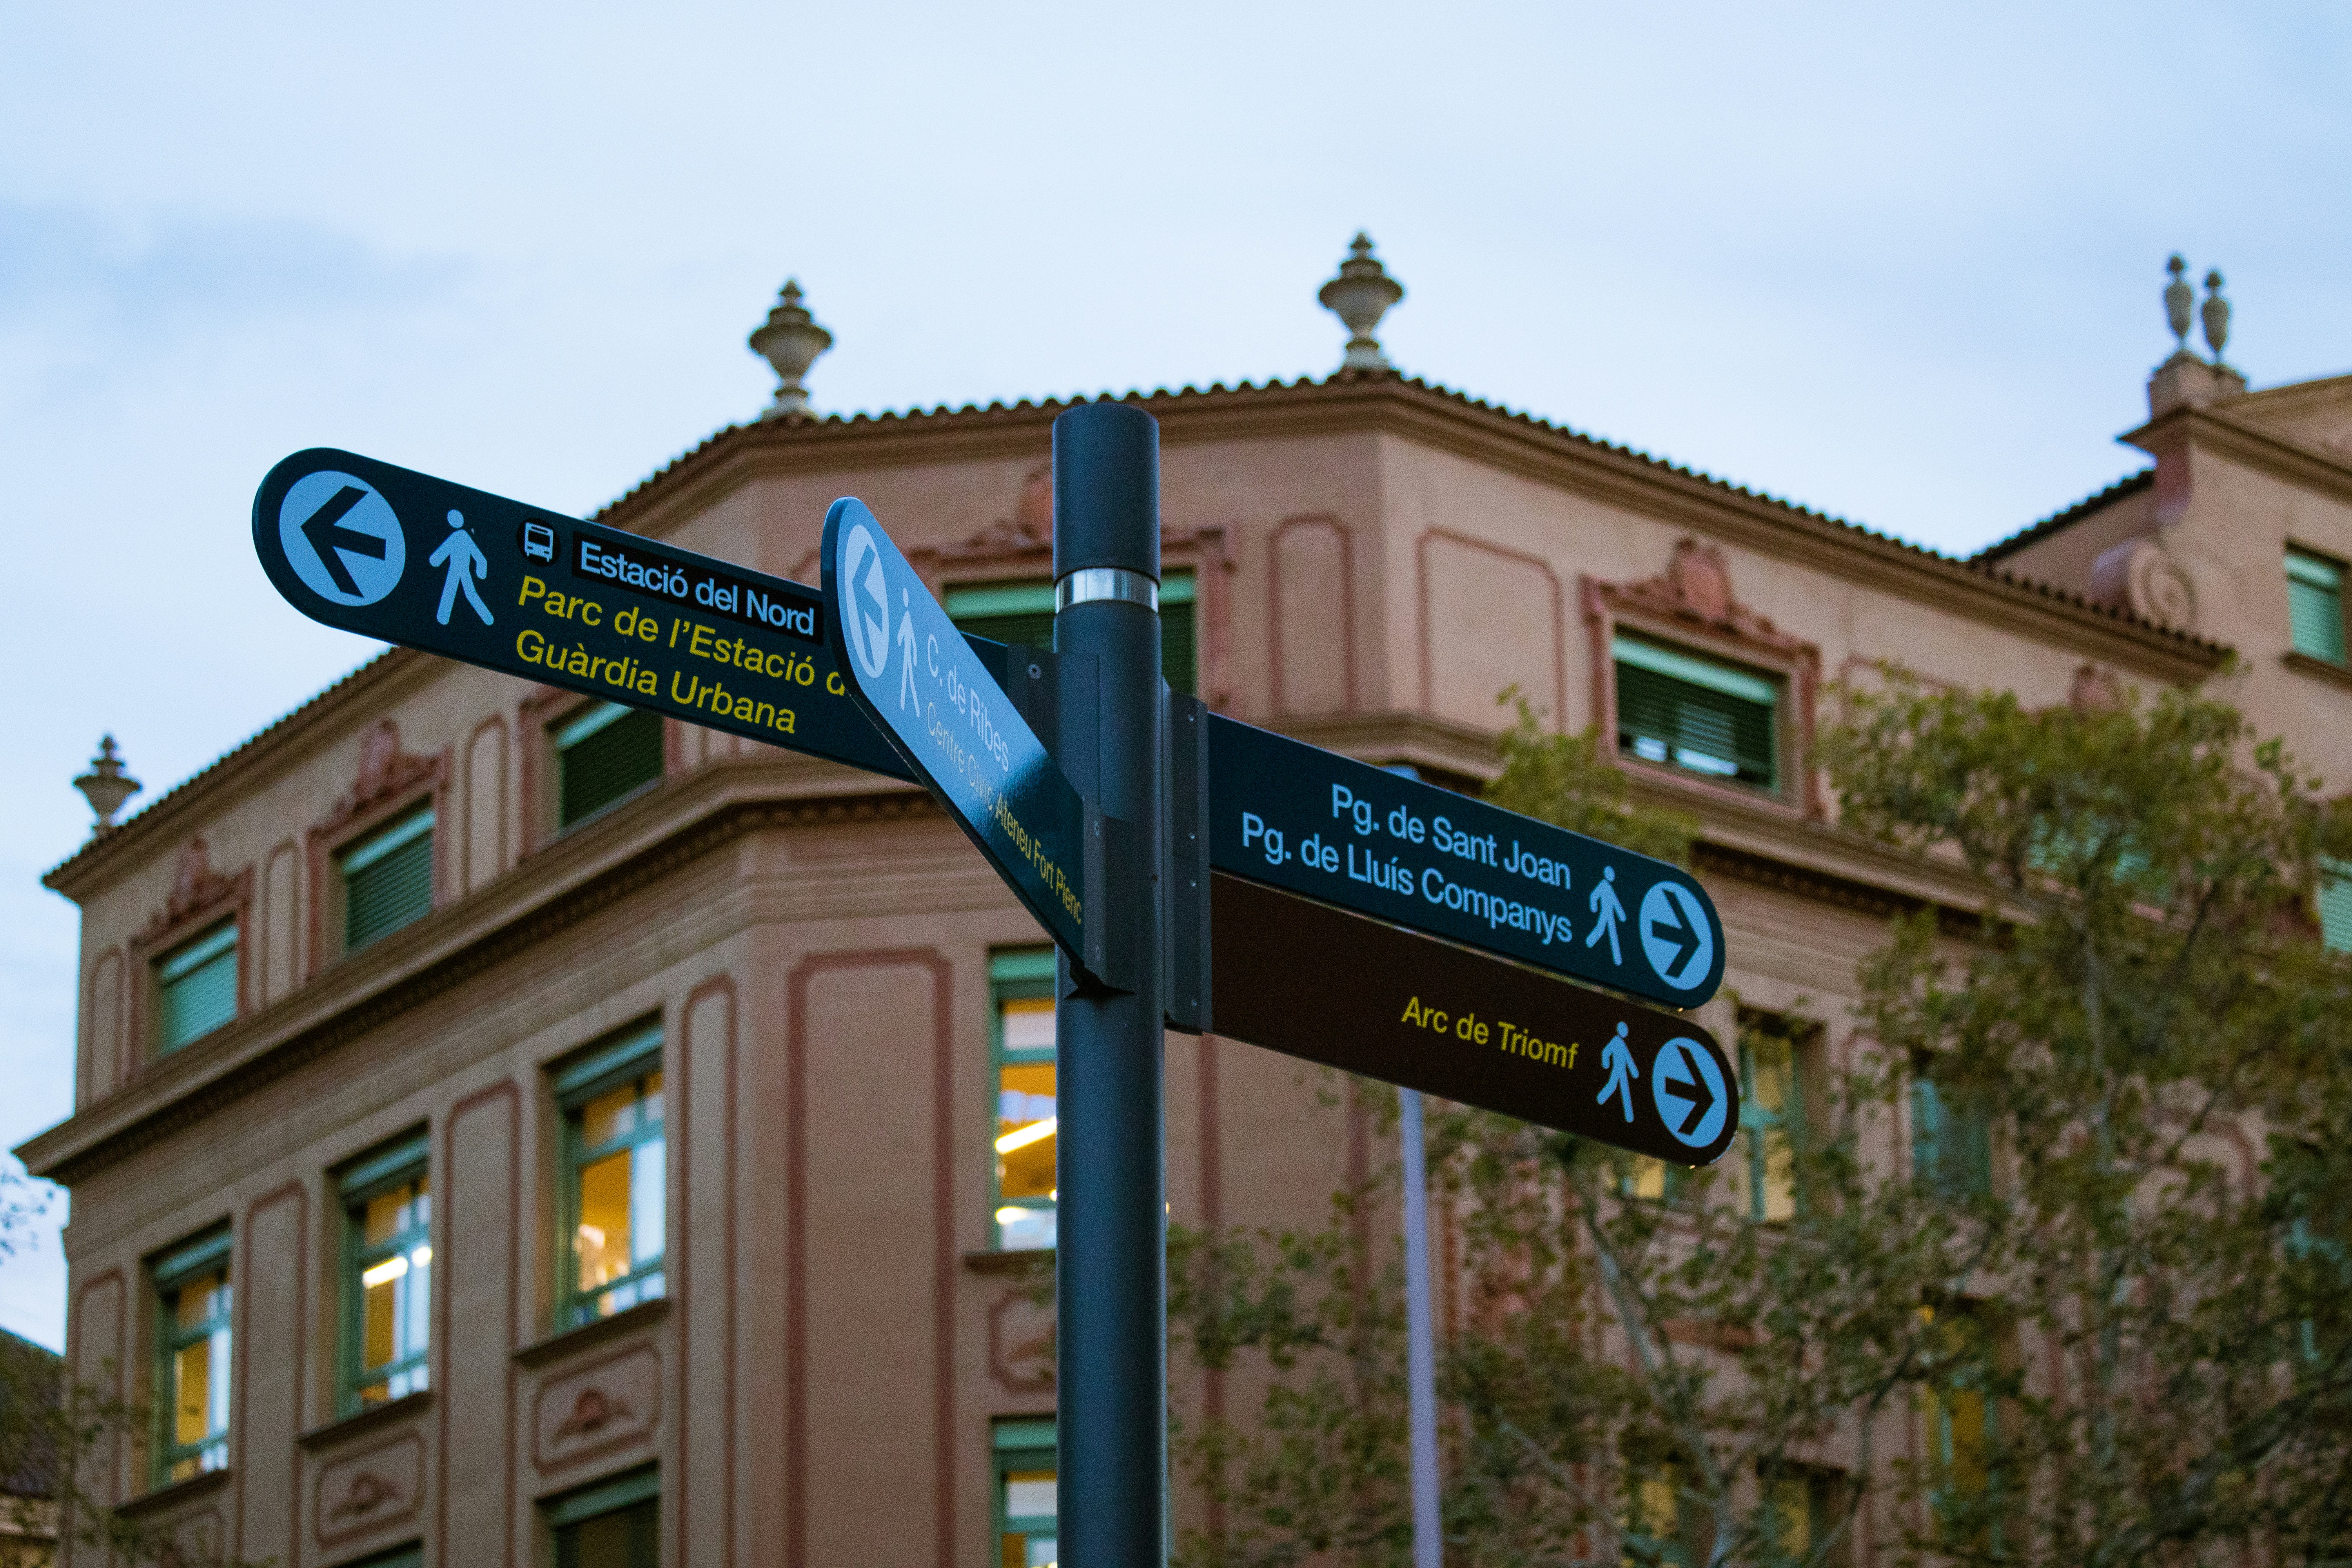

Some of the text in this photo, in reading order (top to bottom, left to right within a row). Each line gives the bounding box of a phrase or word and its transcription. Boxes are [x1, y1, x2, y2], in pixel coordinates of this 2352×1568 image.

[518, 575, 602, 626] Parc
[614, 607, 659, 642] de
[581, 541, 815, 636] Estació del Nord
[516, 630, 795, 733] Guàrdia Urbana
[927, 633, 1009, 772] C. de Ribes
[927, 702, 964, 773] Centre
[995, 792, 1031, 860] Ateneu
[1034, 838, 1054, 890] Fort
[1056, 867, 1082, 924] Pienc
[1332, 784, 1571, 889] Pg. de Sant Joan
[1243, 812, 1572, 945] Pg. de Lluís Companys
[1401, 996, 1579, 1069] Arc de Triomf
